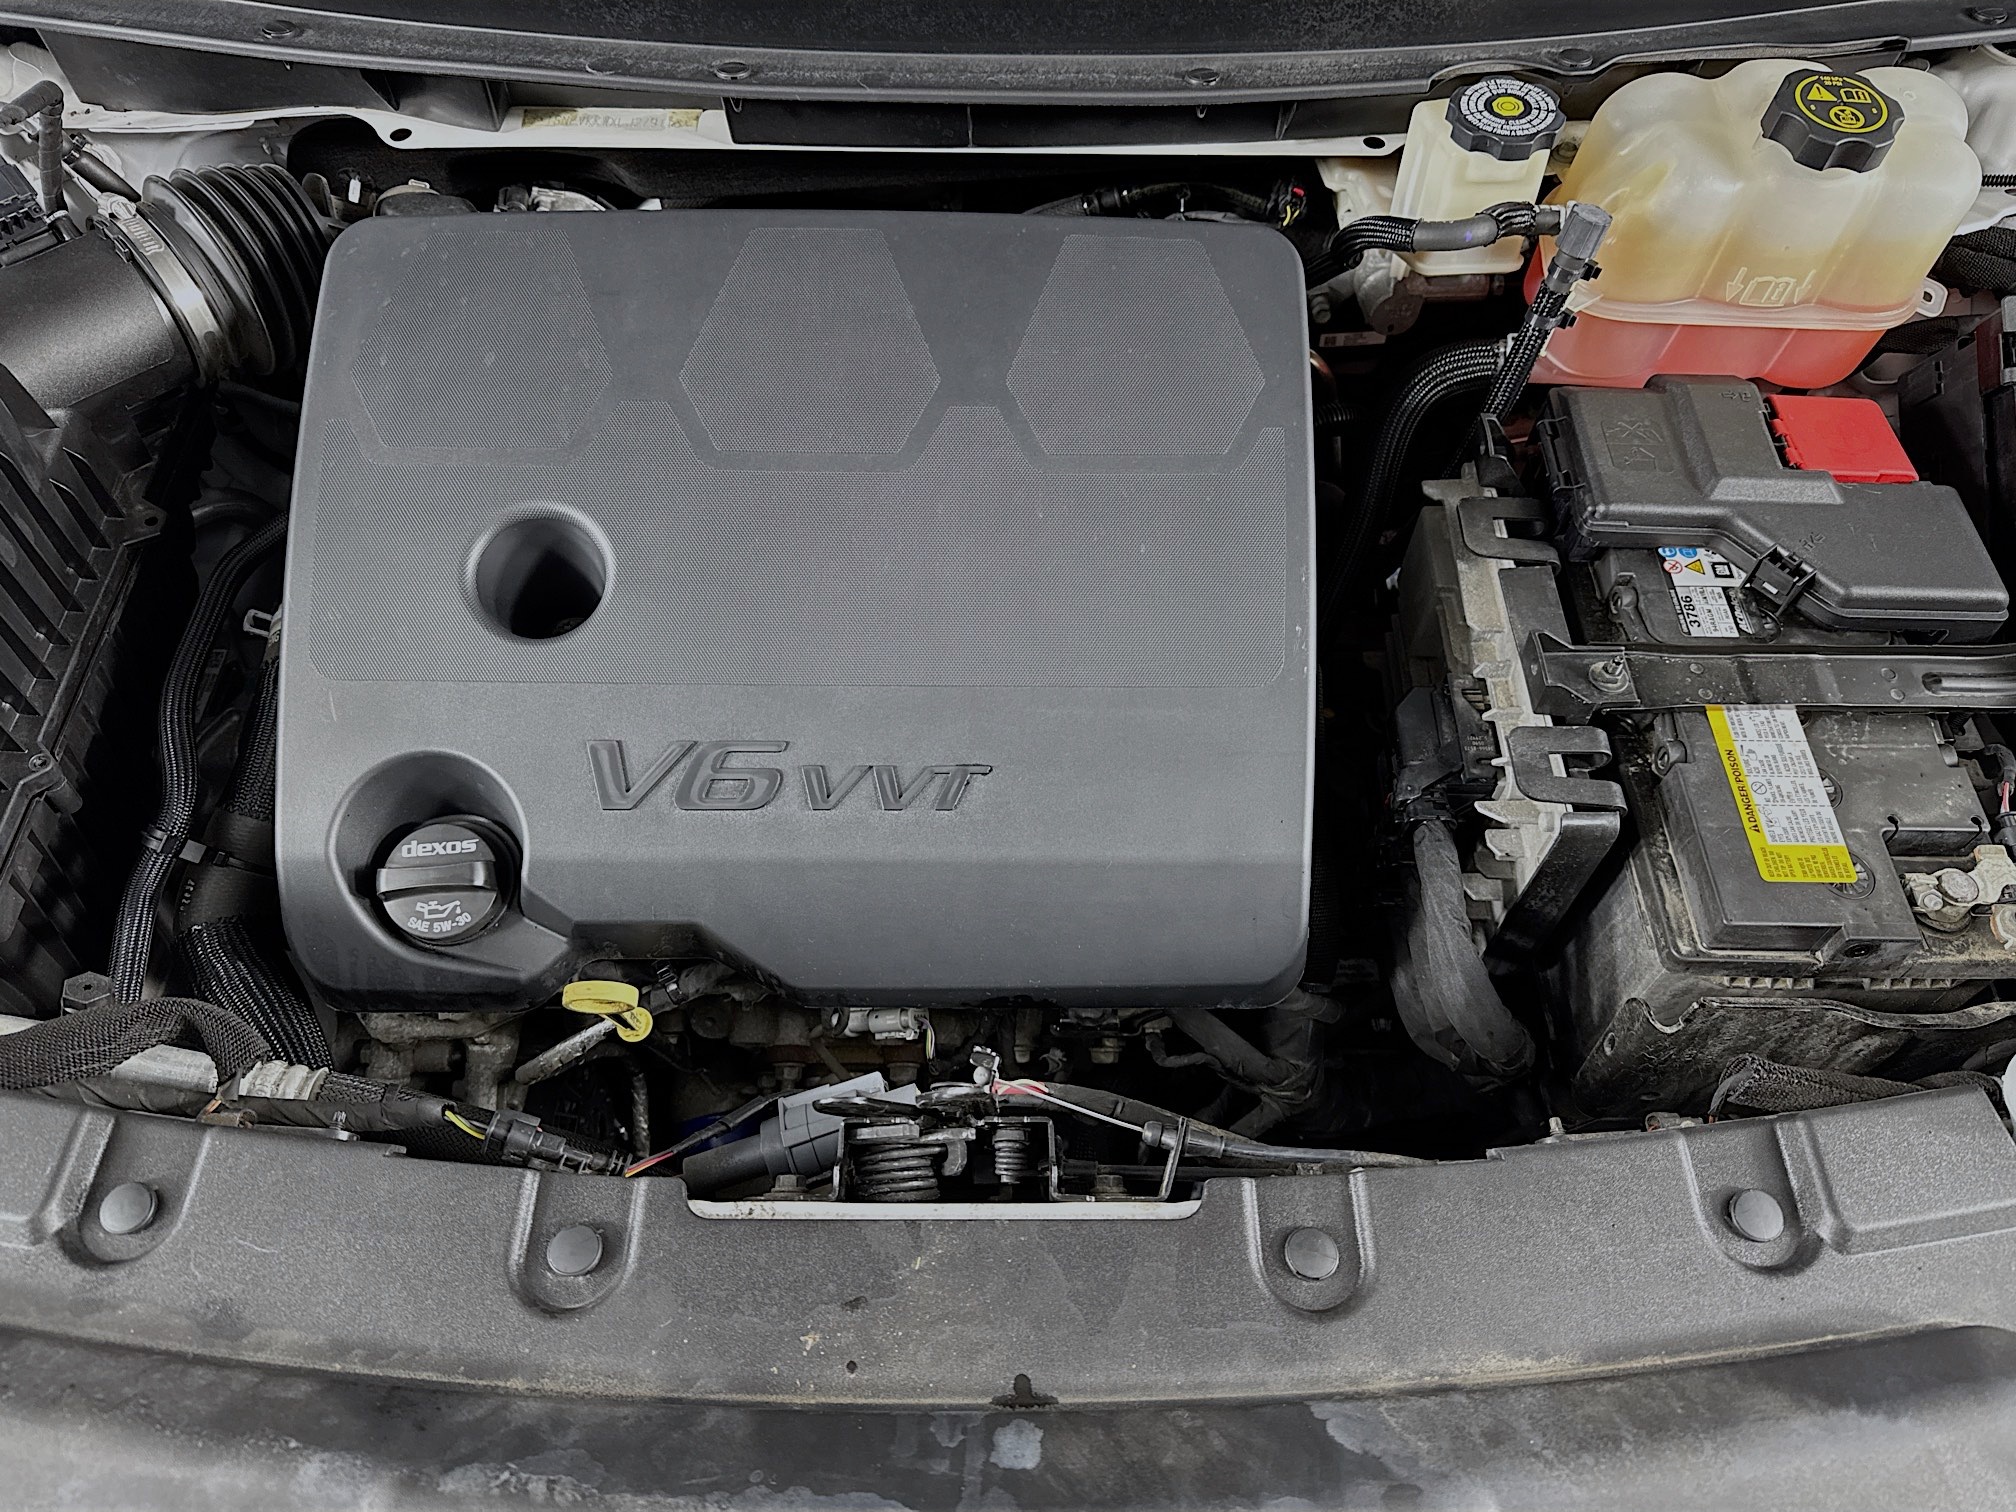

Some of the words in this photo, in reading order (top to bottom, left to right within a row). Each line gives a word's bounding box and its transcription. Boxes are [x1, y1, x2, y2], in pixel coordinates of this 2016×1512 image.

[1681, 595, 1700, 628] 3786
[587, 740, 790, 811] V6
[802, 764, 993, 812] VVT
[1725, 749, 1758, 823] DANGER/POISON
[402, 838, 480, 858] dexos
[408, 916, 430, 932] SAE
[433, 912, 472, 932] 5W-30
